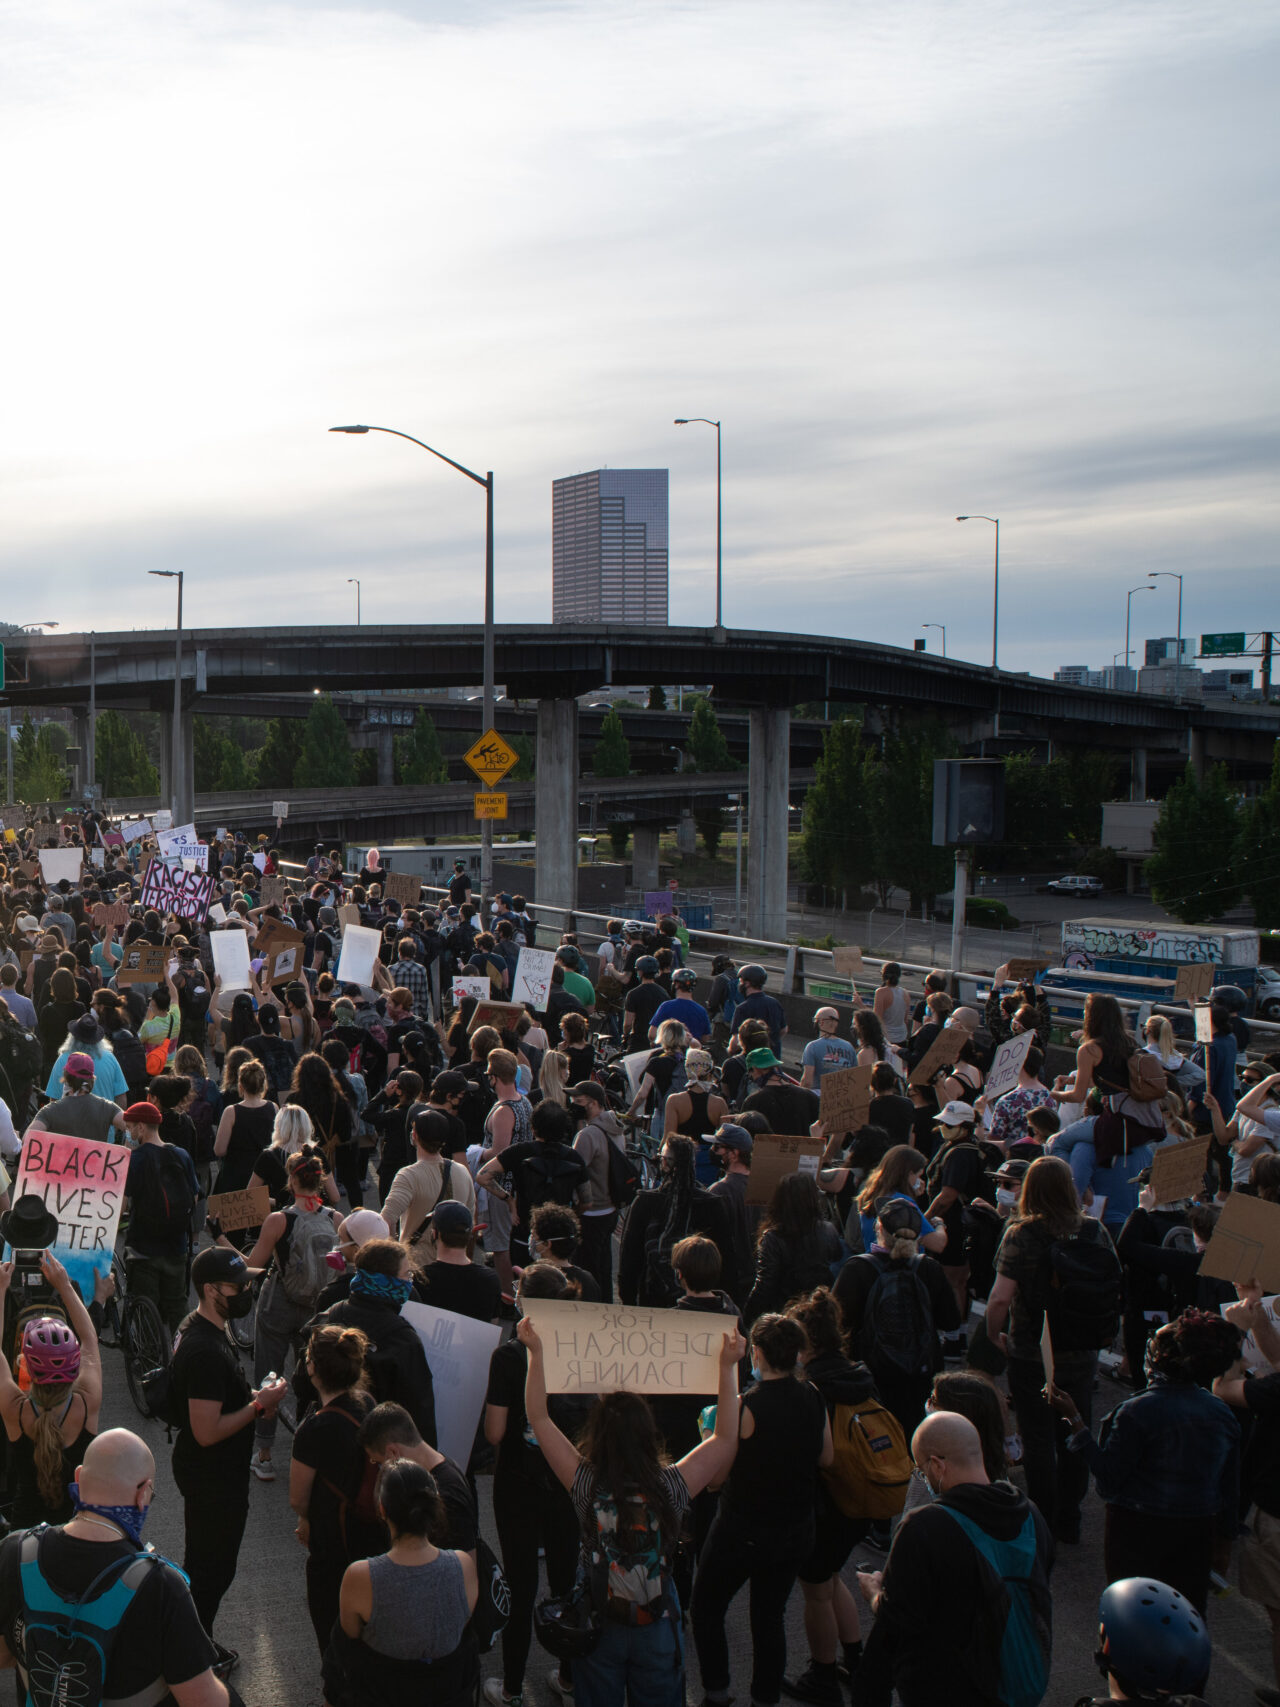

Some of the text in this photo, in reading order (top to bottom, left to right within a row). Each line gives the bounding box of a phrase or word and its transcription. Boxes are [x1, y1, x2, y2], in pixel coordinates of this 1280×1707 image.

[477, 797, 505, 805] PAVEMENT
[180, 846, 207, 857] JUSTICE
[145, 859, 214, 898] RACISM
[142, 885, 210, 923] TERRORISM
[999, 1041, 1024, 1067] DO
[825, 1071, 856, 1089] BLACK
[989, 1063, 1019, 1089] BETTER
[25, 1138, 125, 1182] BLACK
[221, 1191, 253, 1205] BLACK
[221, 1204, 256, 1218] LIVES
[222, 1214, 264, 1229] MATTER
